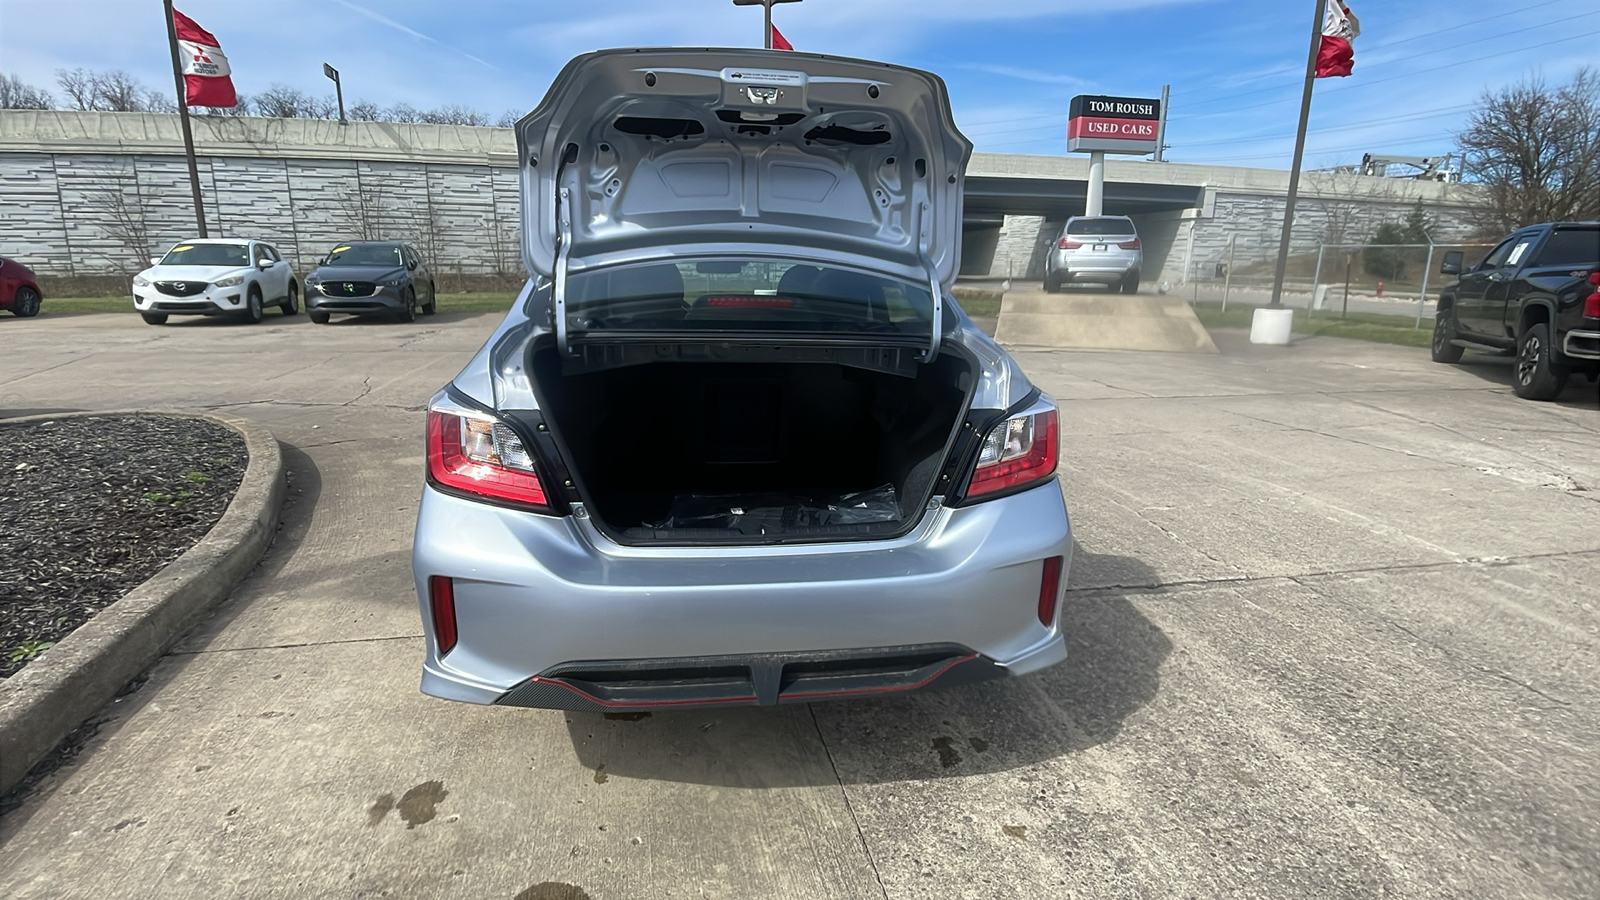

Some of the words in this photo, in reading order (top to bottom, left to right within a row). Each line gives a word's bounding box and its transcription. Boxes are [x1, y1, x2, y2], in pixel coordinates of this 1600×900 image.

[1089, 101, 1114, 112] TOM
[1116, 103, 1153, 115] ROUSH
[1088, 122, 1119, 133] USED
[1121, 124, 1153, 135] CARS
